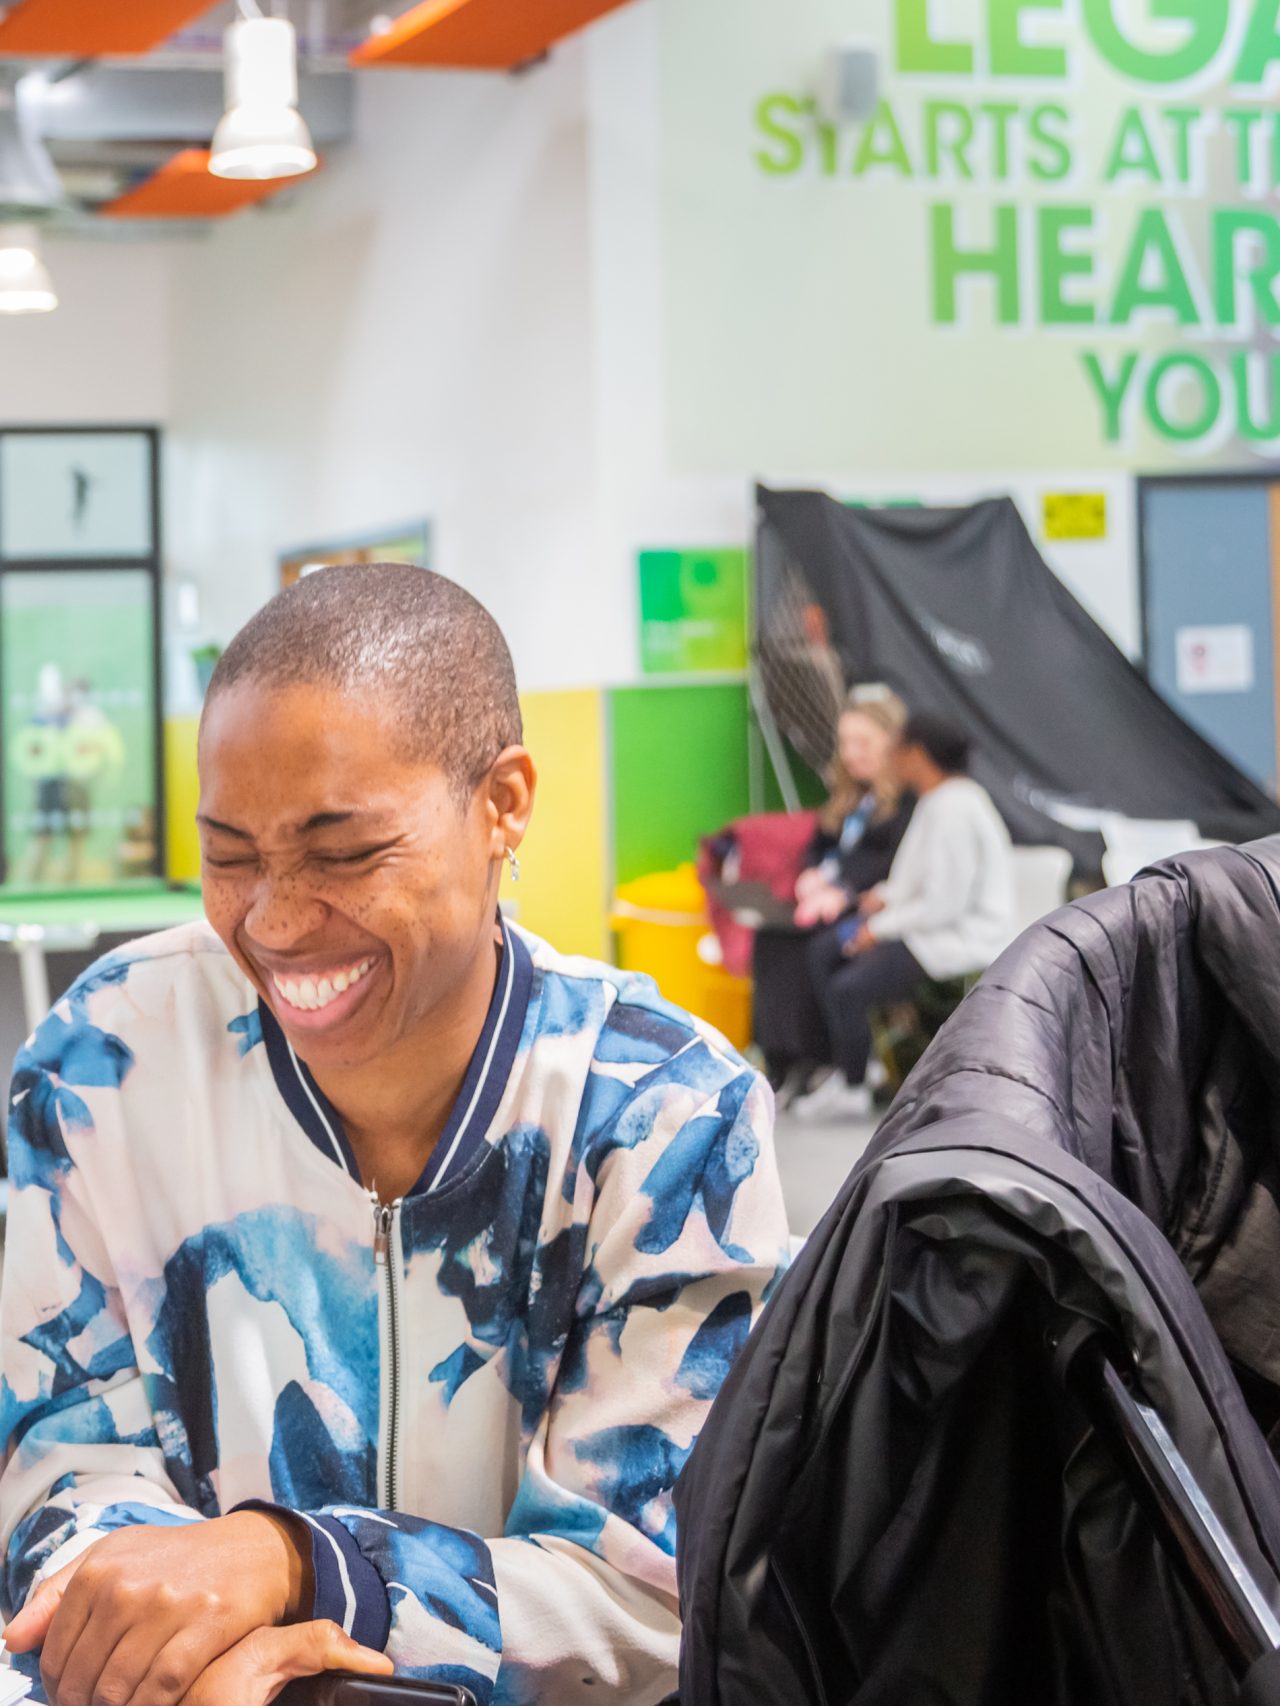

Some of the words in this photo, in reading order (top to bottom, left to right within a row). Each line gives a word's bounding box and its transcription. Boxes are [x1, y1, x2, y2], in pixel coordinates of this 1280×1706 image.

[893, 0, 1280, 84] LEG
[1104, 106, 1201, 183] AT
[1223, 107, 1280, 185] T
[930, 202, 1280, 327] HEAR
